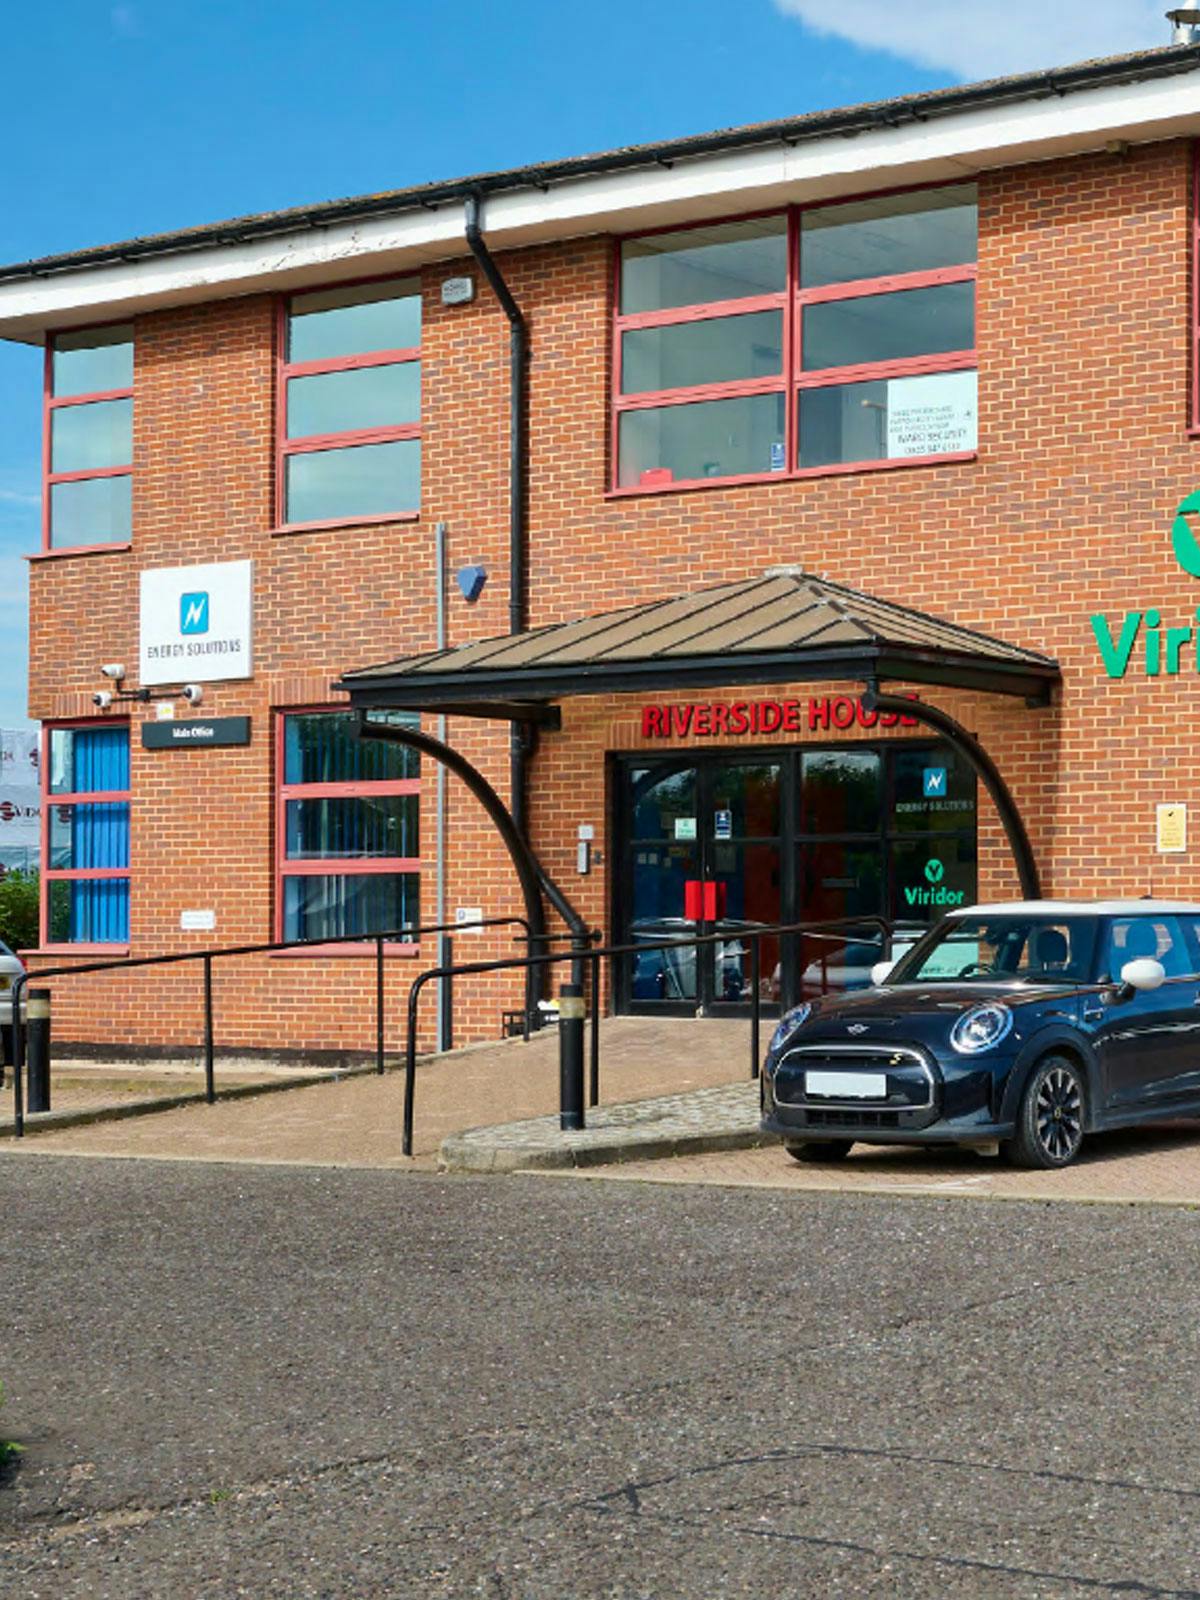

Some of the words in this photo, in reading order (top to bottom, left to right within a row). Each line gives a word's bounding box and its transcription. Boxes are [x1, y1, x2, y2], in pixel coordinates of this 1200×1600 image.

[147, 643, 185, 659] ENERGY
[186, 638, 241, 657] SOLUTIONS
[641, 700, 800, 738] RIVERSIDE
[191, 726, 214, 738] Office
[904, 886, 965, 906] Viridor
